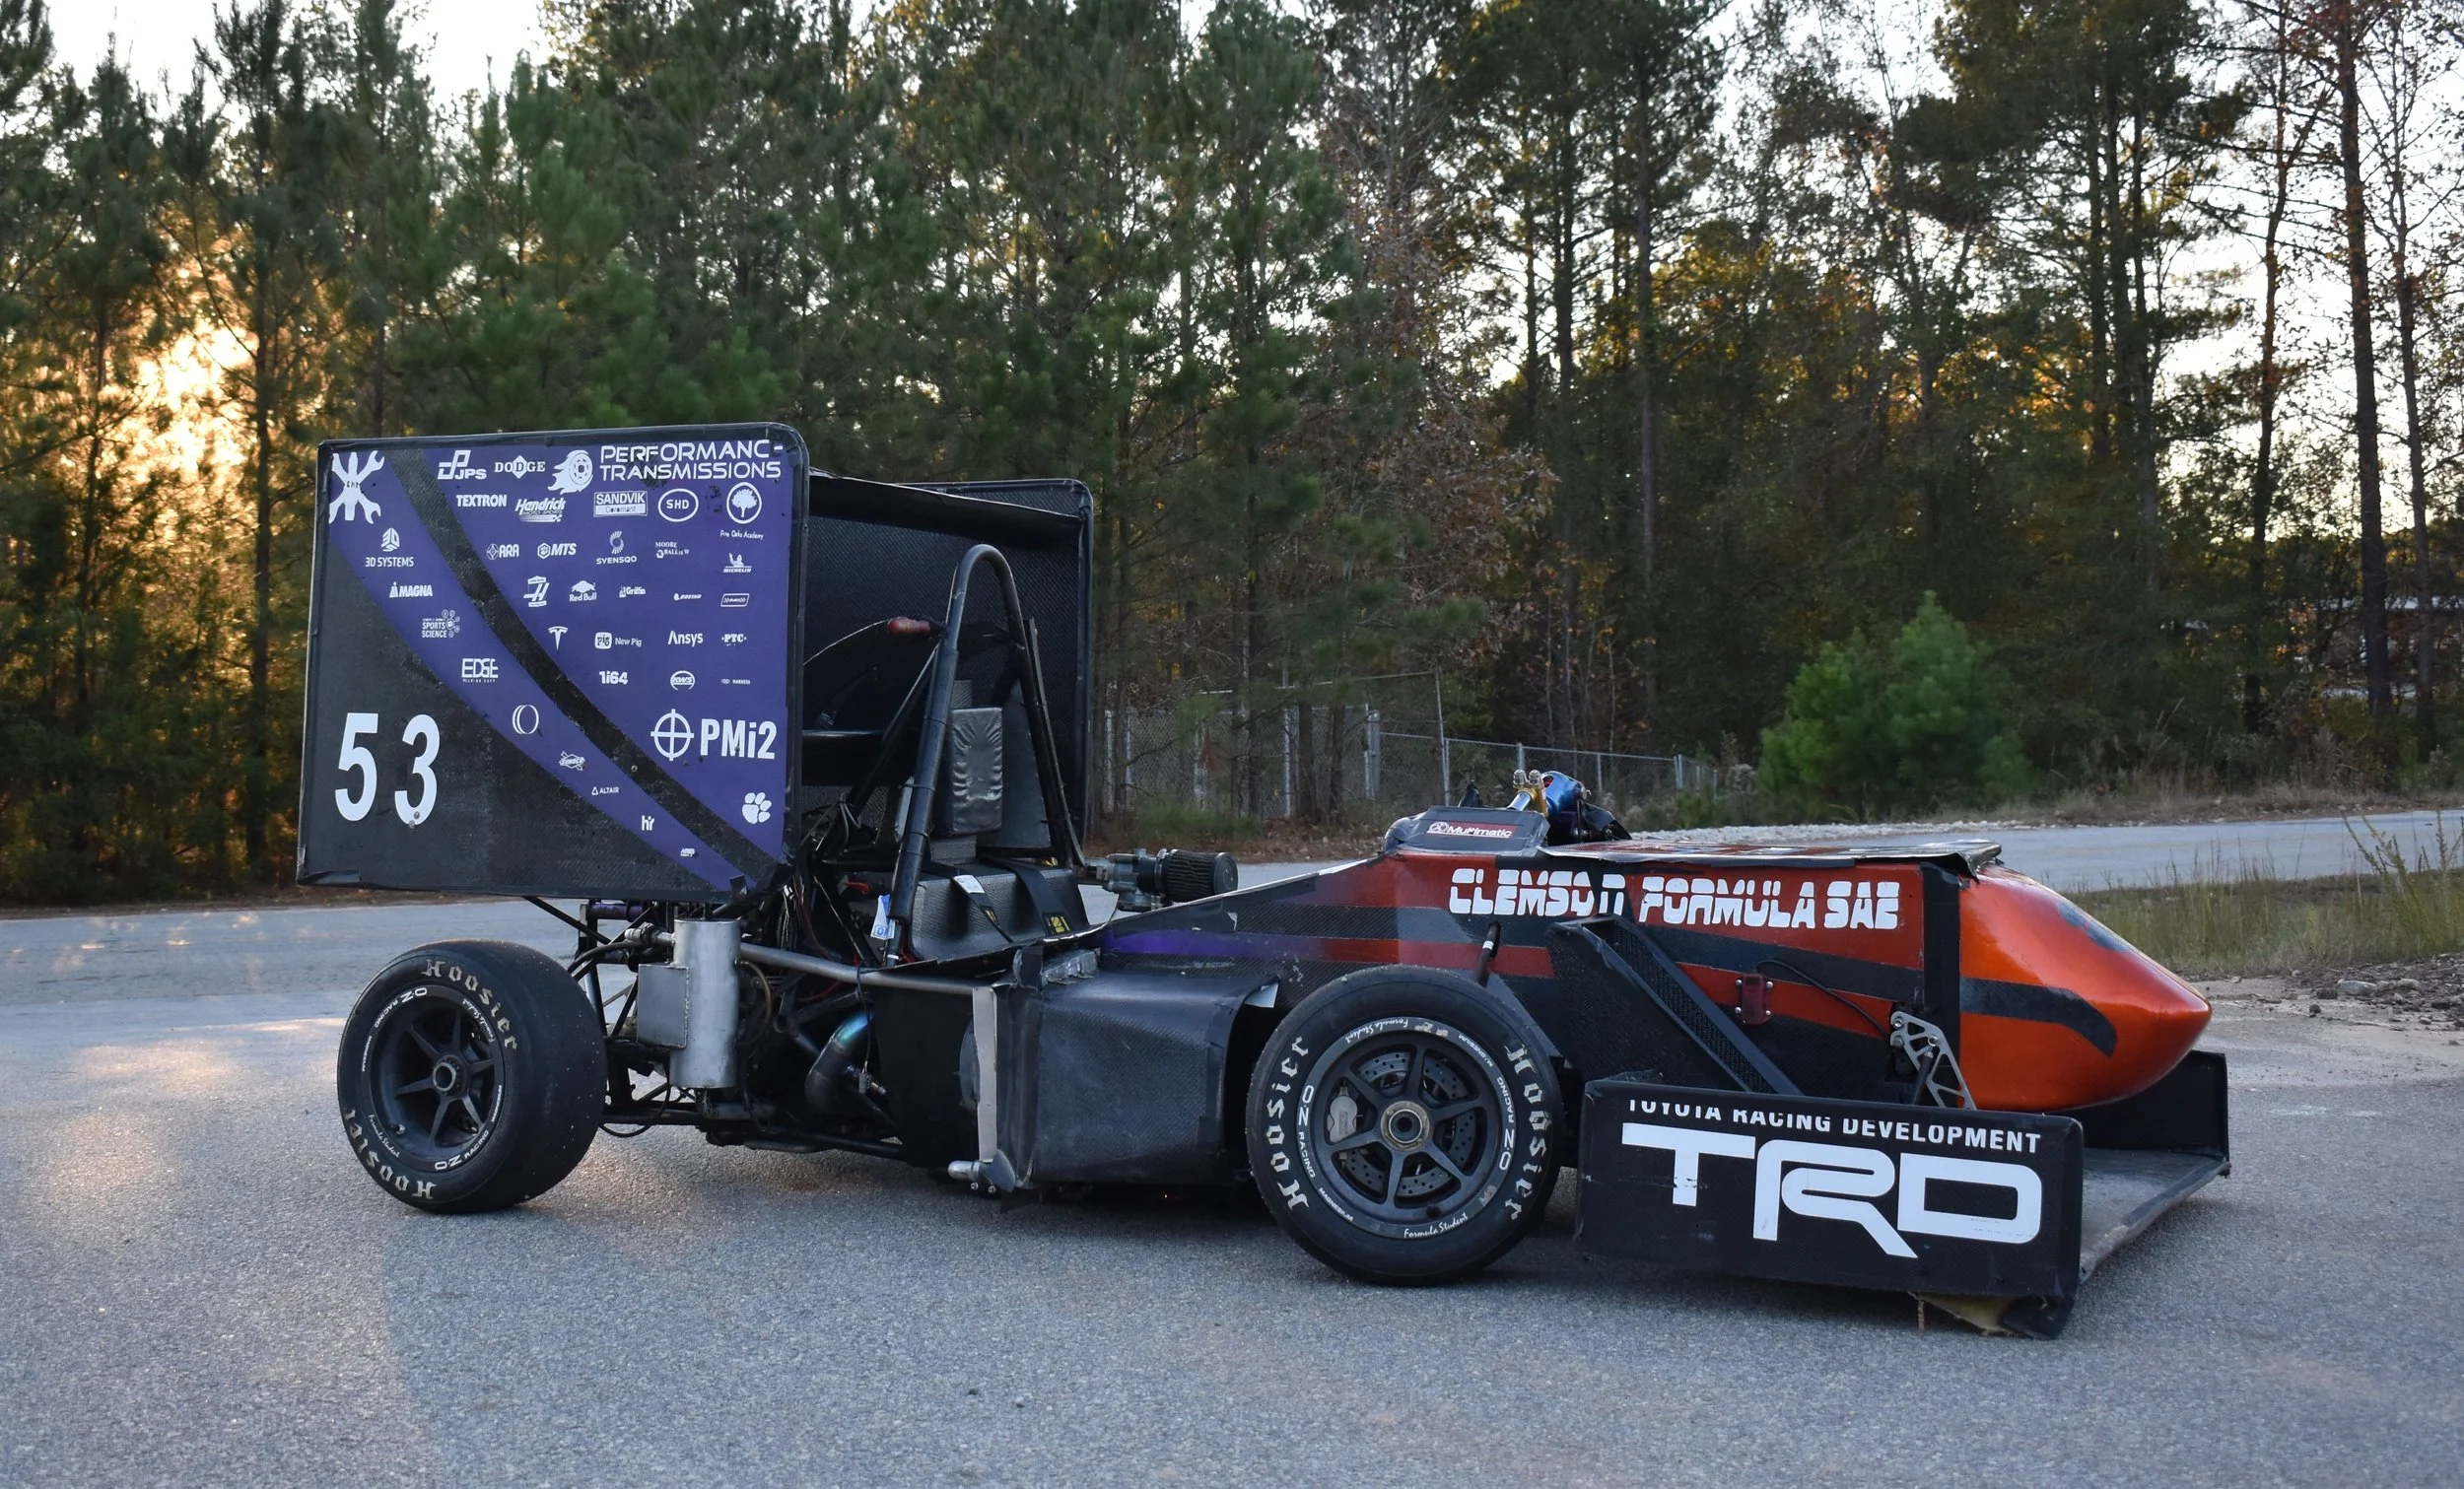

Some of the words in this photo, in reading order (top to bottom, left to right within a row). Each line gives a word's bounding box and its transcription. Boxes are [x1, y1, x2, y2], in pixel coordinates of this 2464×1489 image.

[600, 440, 784, 463] PERFORMANC
[454, 468, 487, 480] JPS
[494, 461, 545, 473] DODGE
[599, 461, 782, 481] TRANSMISSIONS
[456, 494, 508, 507] TEXTRON
[514, 498, 567, 515] Hendrick
[595, 492, 646, 506] SANDVIK
[666, 499, 690, 509] SHD
[499, 543, 520, 558] ARA
[551, 542, 578, 556] MTS
[365, 557, 376, 568] 3D
[377, 557, 415, 568] SYSTEMS
[399, 584, 434, 597] MAGNA
[569, 593, 583, 602] Red
[583, 592, 597, 601] Bull
[615, 637, 630, 646] New
[630, 637, 643, 648] Pig
[667, 630, 704, 647] Ansys
[461, 657, 499, 679] EDGE
[700, 717, 778, 760] PMi2
[1447, 825, 1513, 838] Multimatic
[1449, 868, 1626, 917] CLEMSON
[1638, 876, 1815, 929] FORMULA
[1823, 880, 1900, 930] SAE
[374, 998, 399, 1029] RACING
[421, 959, 518, 1051] Hoosier
[1496, 1076, 1514, 1123] RACING
[1266, 1036, 1310, 1211] Hoosier
[1504, 1044, 1553, 1221] Hoosier
[1733, 1109, 1832, 1132] RACING
[1842, 1117, 2041, 1154] DEVELOPMENT
[464, 1130, 490, 1159] RACING
[1298, 1131, 1316, 1179] RACING
[1621, 1122, 2043, 1259] TRD
[1318, 1187, 1354, 1222] MAGNESIUM
[1403, 1226, 1439, 1239] Formula
[1438, 1212, 1469, 1233] Student
